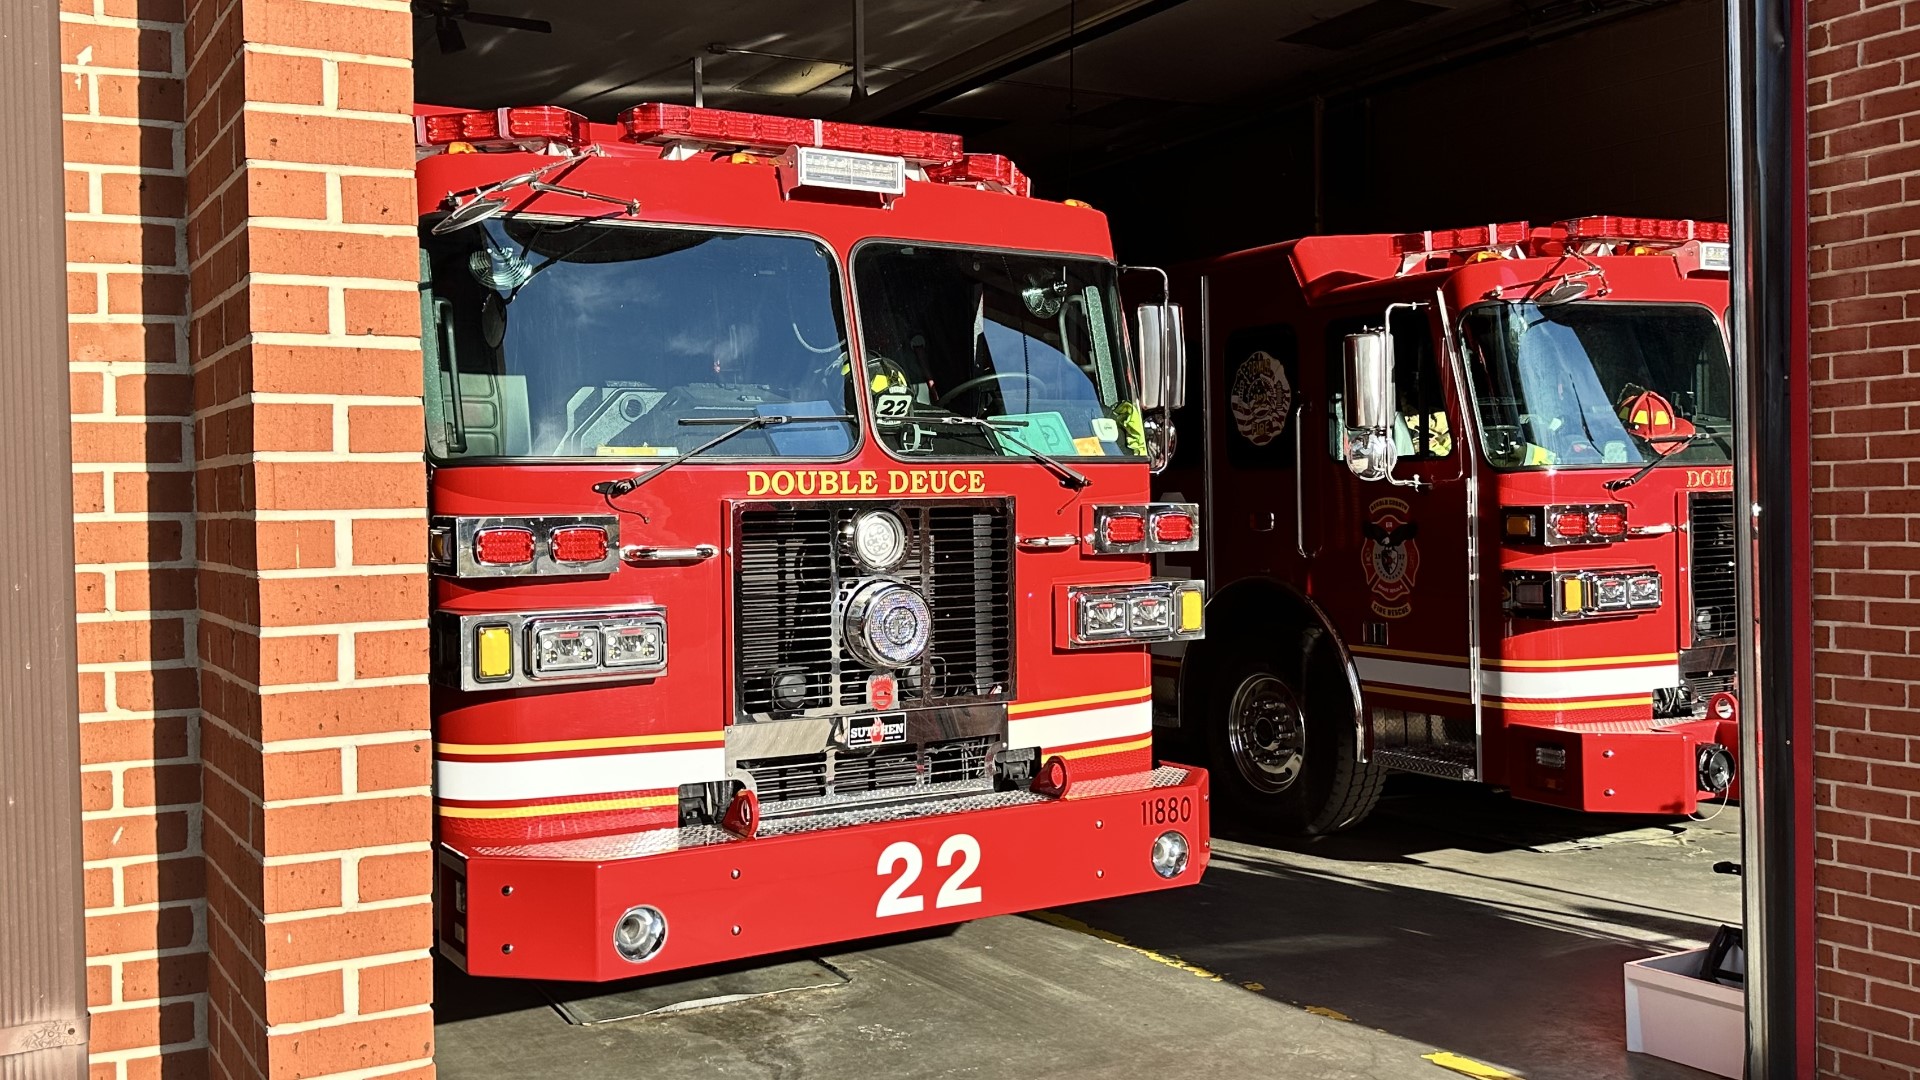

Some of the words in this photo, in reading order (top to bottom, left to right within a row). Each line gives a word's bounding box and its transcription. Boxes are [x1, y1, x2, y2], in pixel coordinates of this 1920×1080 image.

[880, 400, 907, 415] 22
[747, 470, 878, 496] DOUBLE
[888, 470, 986, 494] DEUCE
[1374, 603, 1386, 615] FIRE
[1388, 605, 1409, 617] RESCUE
[851, 723, 905, 739] SUTPHEN
[1141, 796, 1191, 826] 11880
[876, 833, 982, 918] 22
